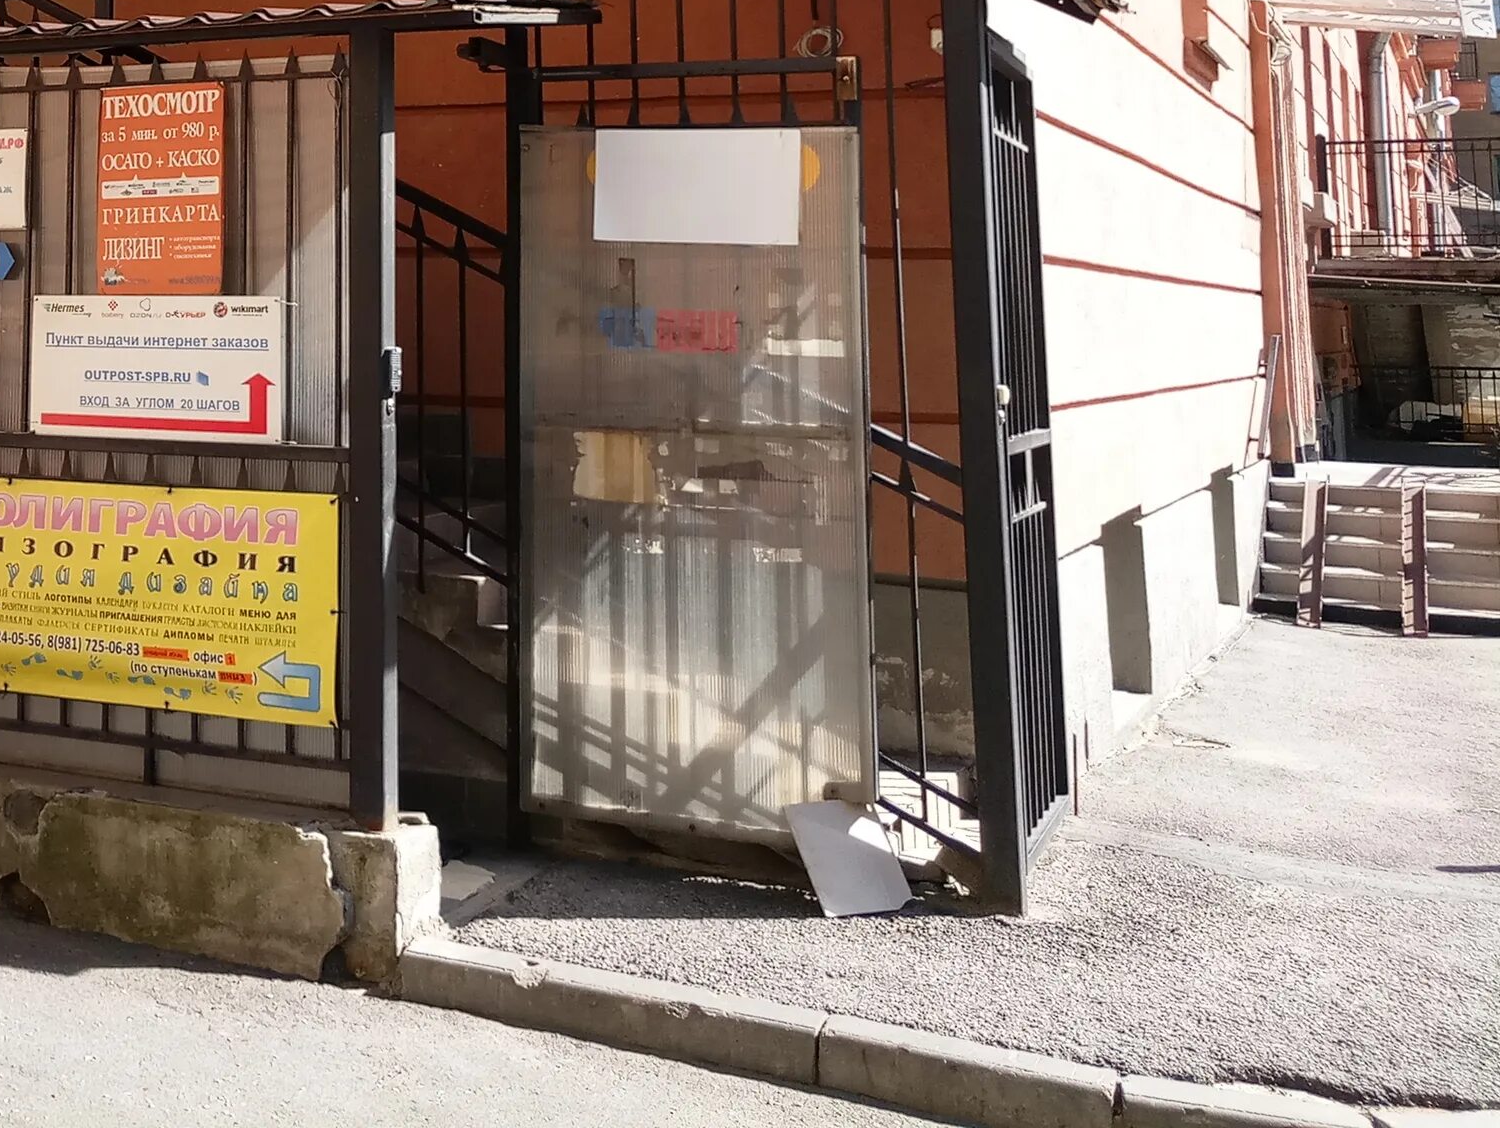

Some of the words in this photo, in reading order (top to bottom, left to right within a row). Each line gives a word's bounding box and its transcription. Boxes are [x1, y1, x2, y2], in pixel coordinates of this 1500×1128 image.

[102, 88, 221, 120] ТЕХОСМОТР
[101, 130, 115, 143] за
[118, 126, 127, 142] 5
[131, 128, 158, 141] мин.
[163, 127, 179, 139] от
[181, 122, 205, 138] 980
[101, 151, 152, 172] ОСАГО
[167, 148, 220, 169] КАСКО
[102, 204, 221, 225] ГРИНКАРТА
[102, 236, 165, 261] ЛИЗИНГ
[51, 302, 85, 313] Hermes
[231, 305, 269, 313] wikimart
[46, 332, 84, 346] Пункт
[87, 334, 140, 347] выдачи
[143, 336, 208, 349] интернет
[211, 337, 269, 348] заказов
[84, 369, 192, 383] OUTPOST-SPB.RU
[80, 395, 110, 408] ВХОД
[115, 396, 130, 407] ЗА
[136, 397, 175, 409] УГЛОМ
[181, 398, 193, 410] 20
[196, 399, 241, 411] ШАГОВ
[117, 571, 299, 604] дизайна
[12, 590, 41, 600] СТИЛЬ
[44, 593, 92, 604] ЛОГОТИПЫ
[183, 605, 235, 616] КАТАЛОГИ
[240, 609, 271, 620] МЕНЮ
[276, 611, 297, 620] ДЛЯ
[0, 614, 33, 625] ПЛАКАТЫ
[84, 622, 159, 637] СЕРТИФИКАТЫ
[163, 629, 214, 642] ДИПЛОМЫ
[219, 633, 250, 645] ПЕЧАТИ
[51, 606, 98, 618] ЖУРНАЛЫ
[100, 610, 163, 623] ПРИГЛАШЕНИЯ
[239, 621, 297, 634] НАКЛЕЙКИ
[47, 634, 82, 652] 8(981)
[85, 638, 140, 656] 725-06-83
[193, 650, 224, 665] офис
[130, 660, 148, 673] (по
[150, 663, 217, 679] ступенькам
